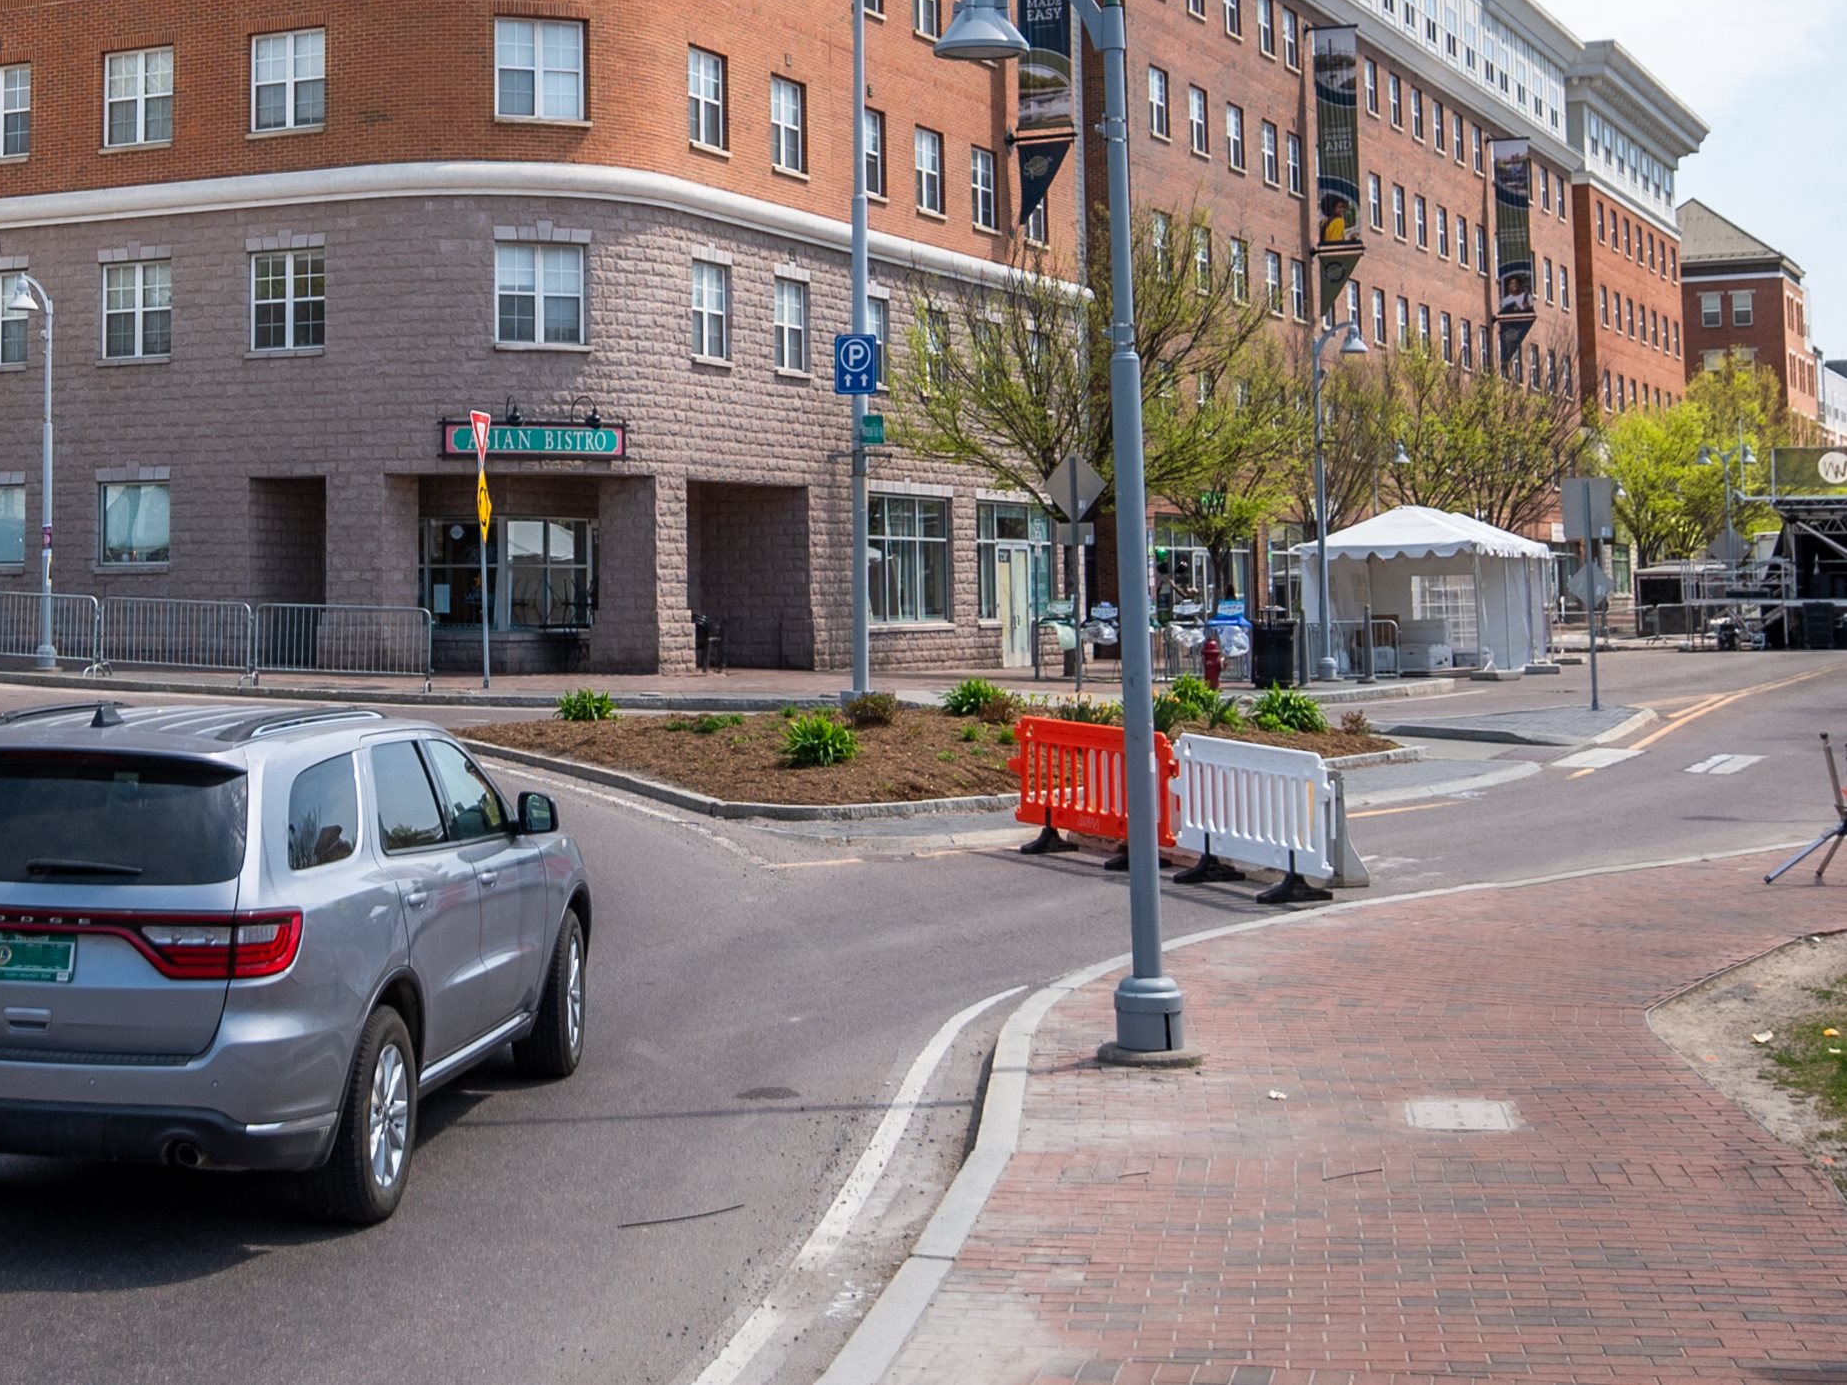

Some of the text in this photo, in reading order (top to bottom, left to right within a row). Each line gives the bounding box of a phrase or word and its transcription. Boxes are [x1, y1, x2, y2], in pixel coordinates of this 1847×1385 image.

[1027, 7, 1063, 22] EASY
[1325, 140, 1352, 151] AND
[848, 344, 865, 367] P
[544, 430, 607, 451] BISTRO
